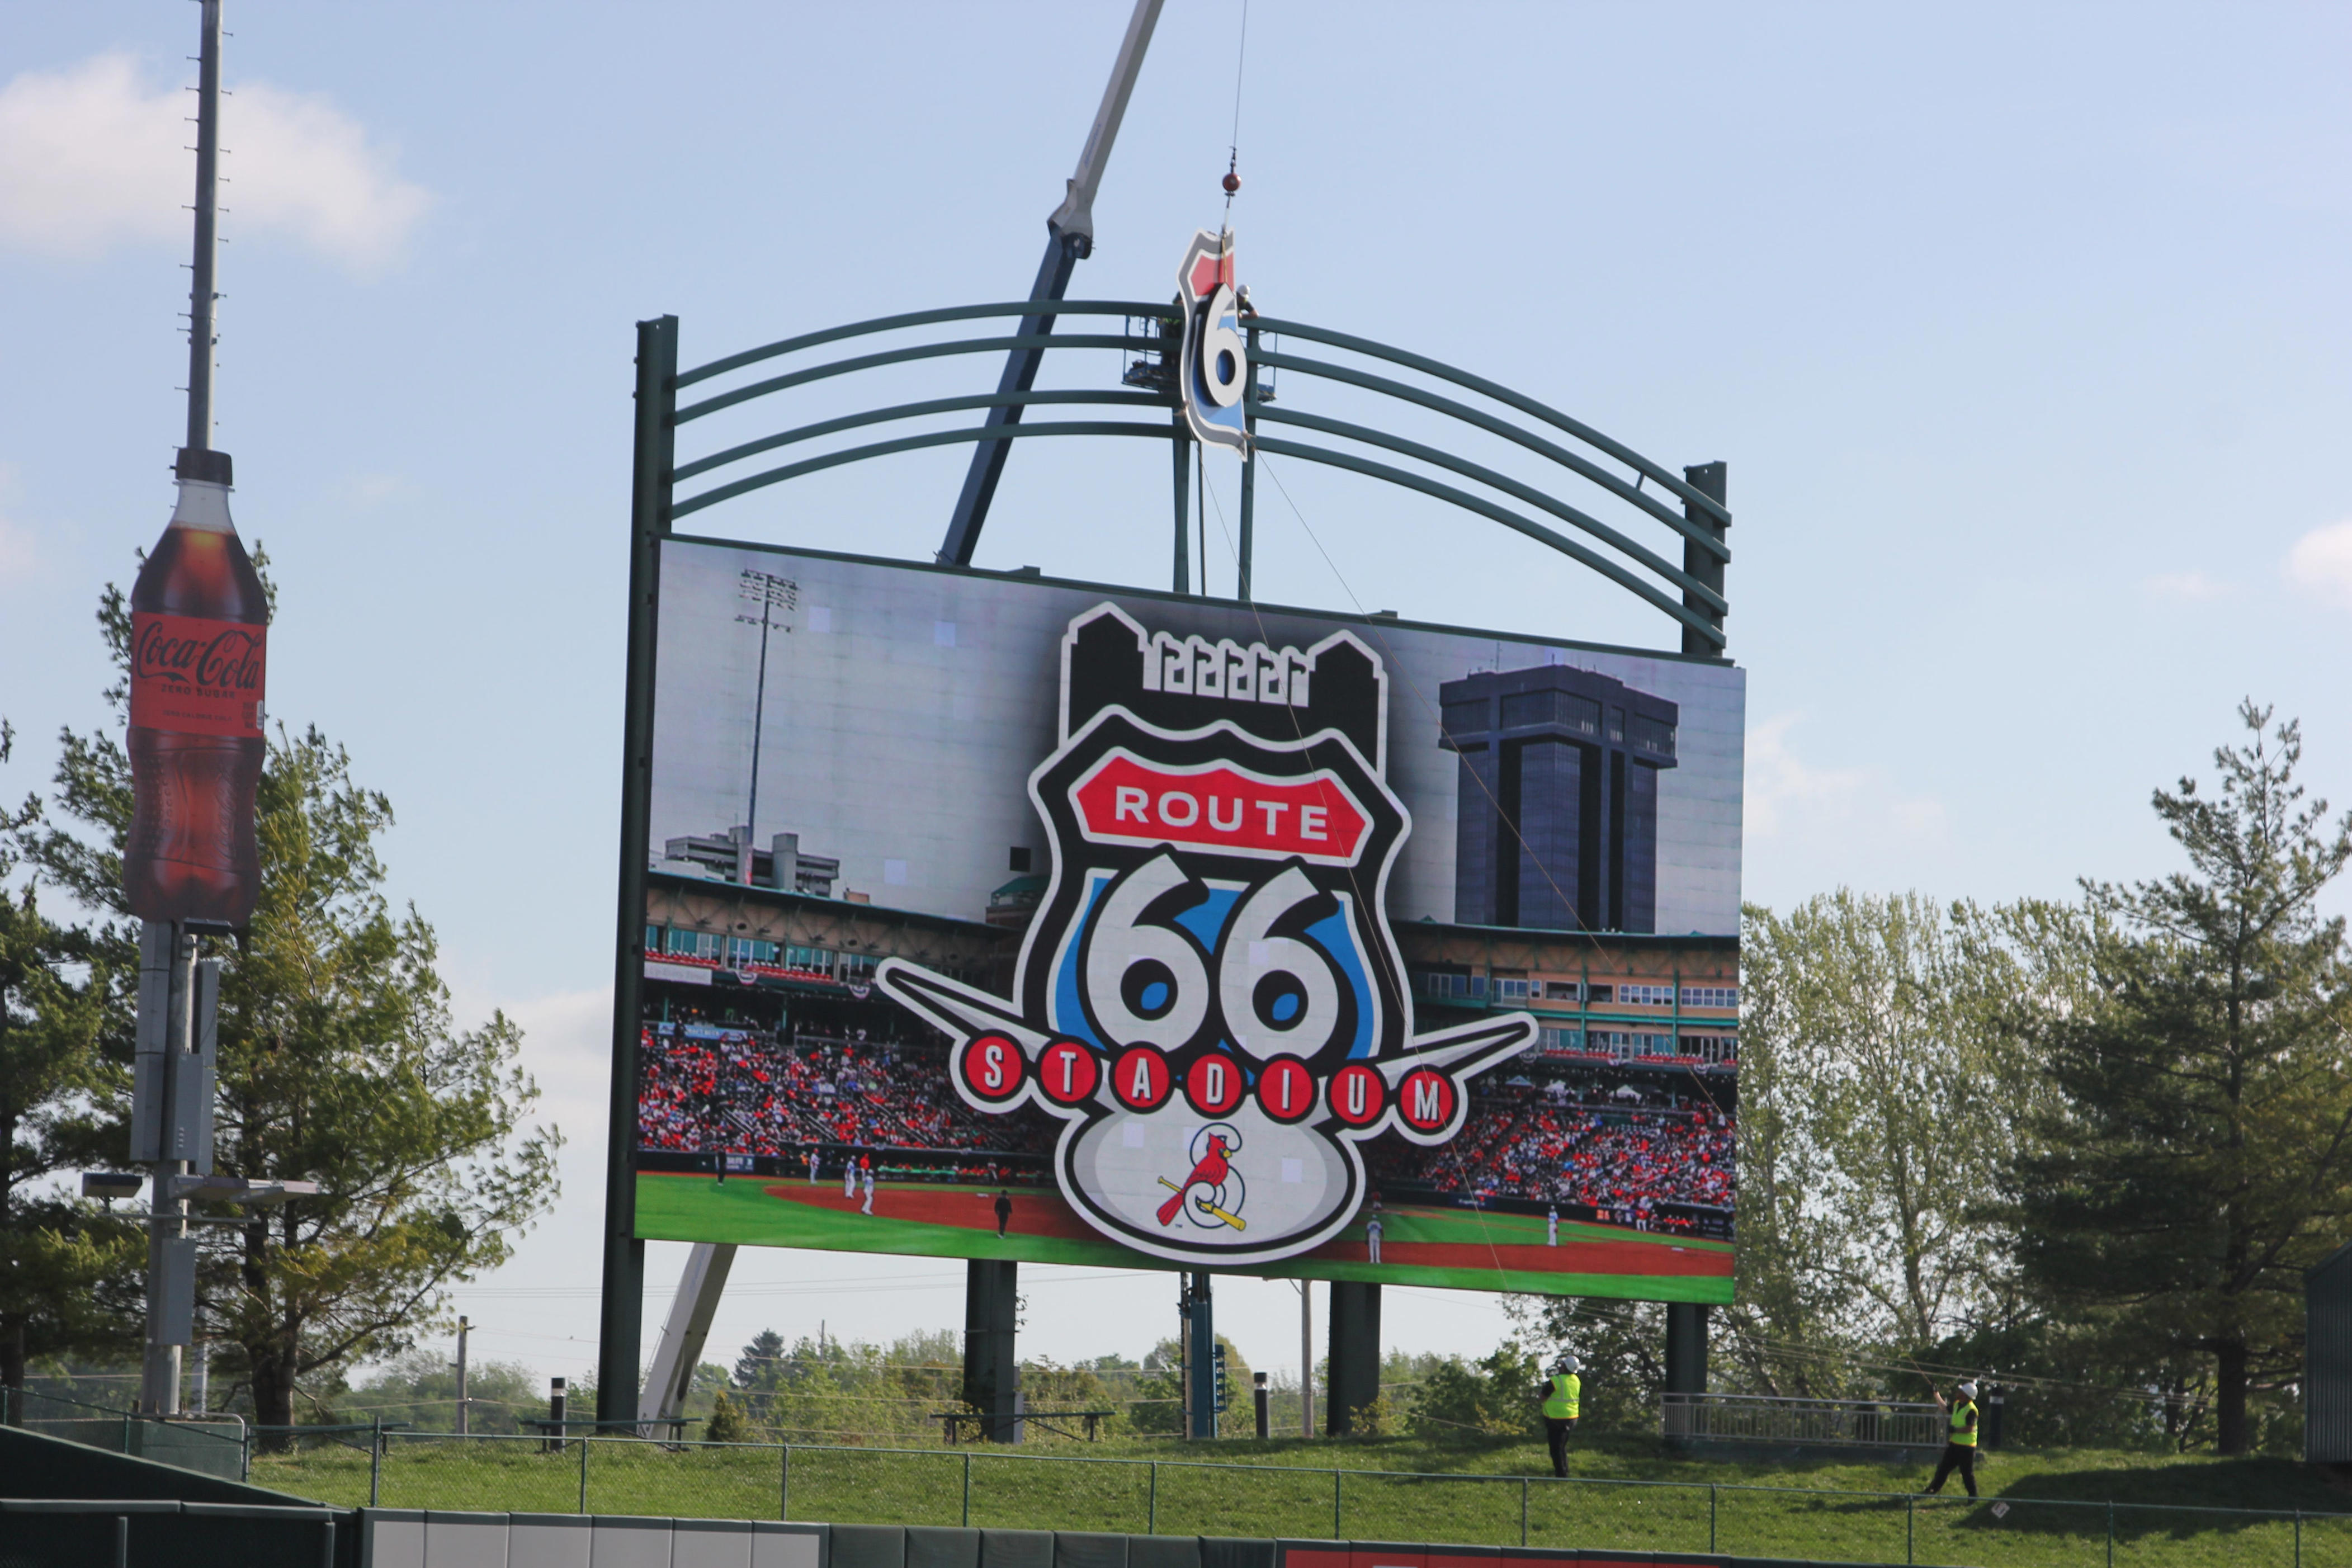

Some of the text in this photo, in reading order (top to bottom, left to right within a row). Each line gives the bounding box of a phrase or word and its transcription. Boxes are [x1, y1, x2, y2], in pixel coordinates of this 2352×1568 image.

[1203, 282, 1247, 408] 6
[137, 621, 263, 689] Coca-Cola
[161, 683, 235, 699] ZERO SUGAR
[1116, 786, 1328, 840] ROUTE
[1087, 853, 1339, 1061] 66
[985, 1045, 1439, 1122] STADIUM
